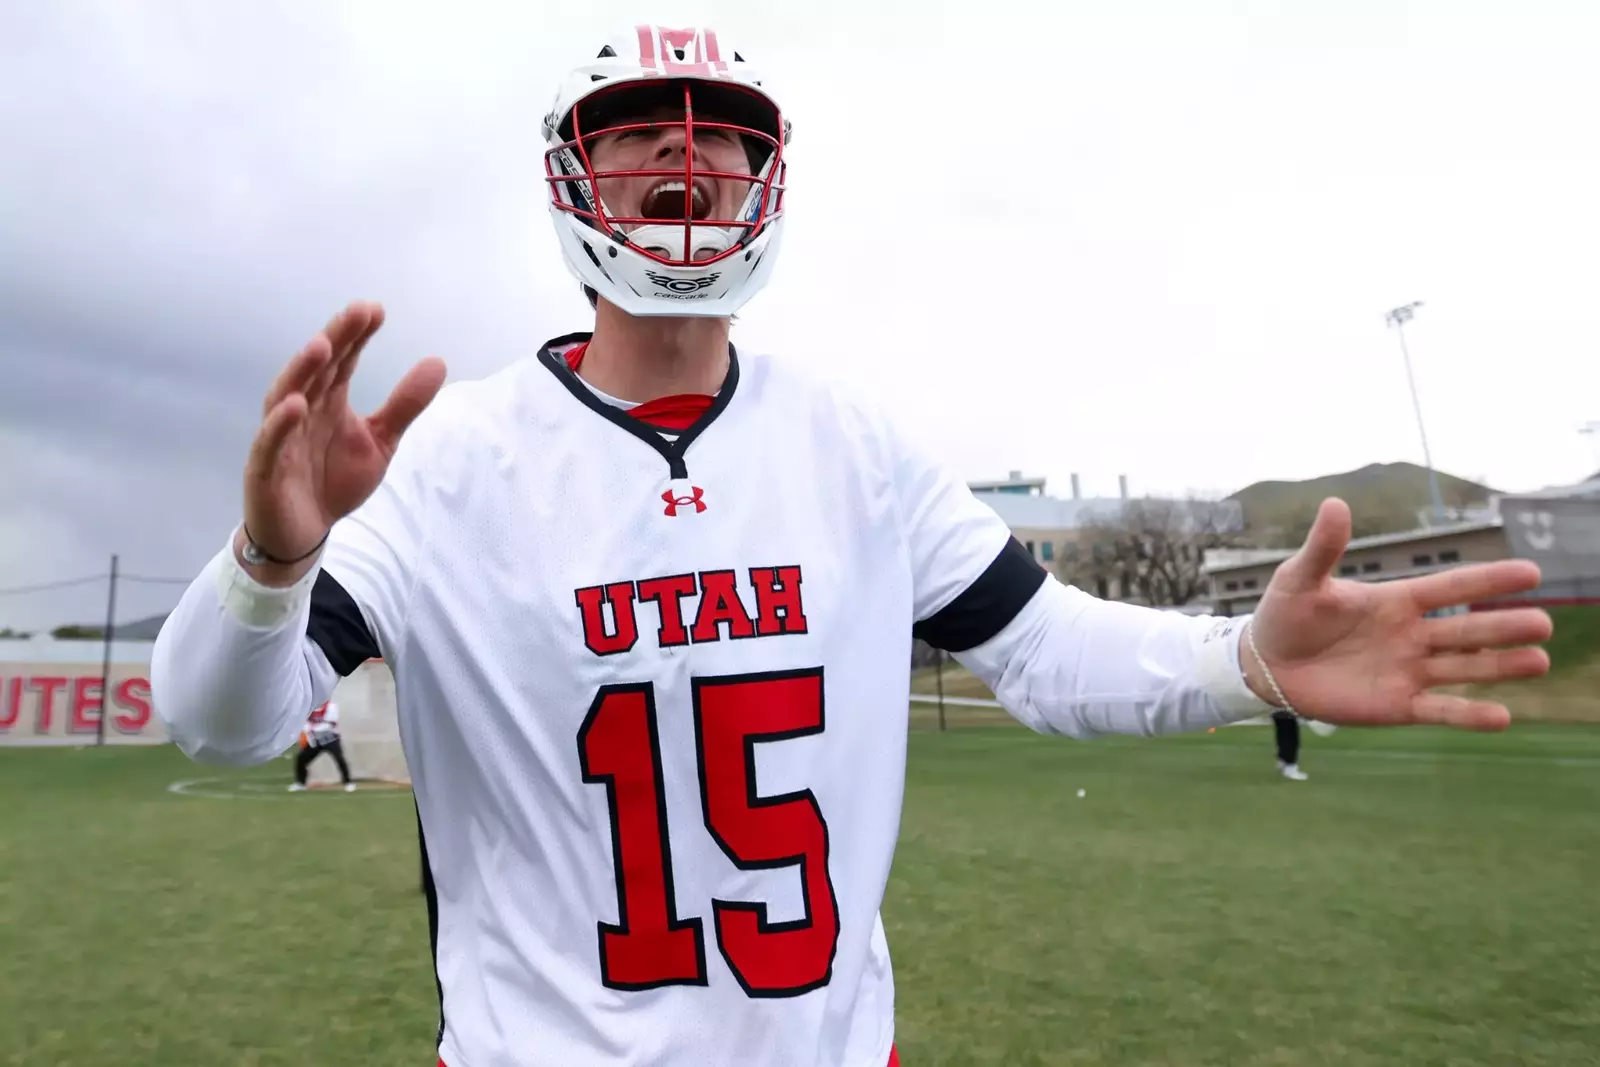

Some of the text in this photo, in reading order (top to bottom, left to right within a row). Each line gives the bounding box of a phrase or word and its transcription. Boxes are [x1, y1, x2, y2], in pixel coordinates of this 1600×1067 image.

[653, 291, 709, 300] cascade
[574, 565, 809, 656] UTAH
[0, 676, 152, 732] UTES
[576, 666, 841, 998] 15
